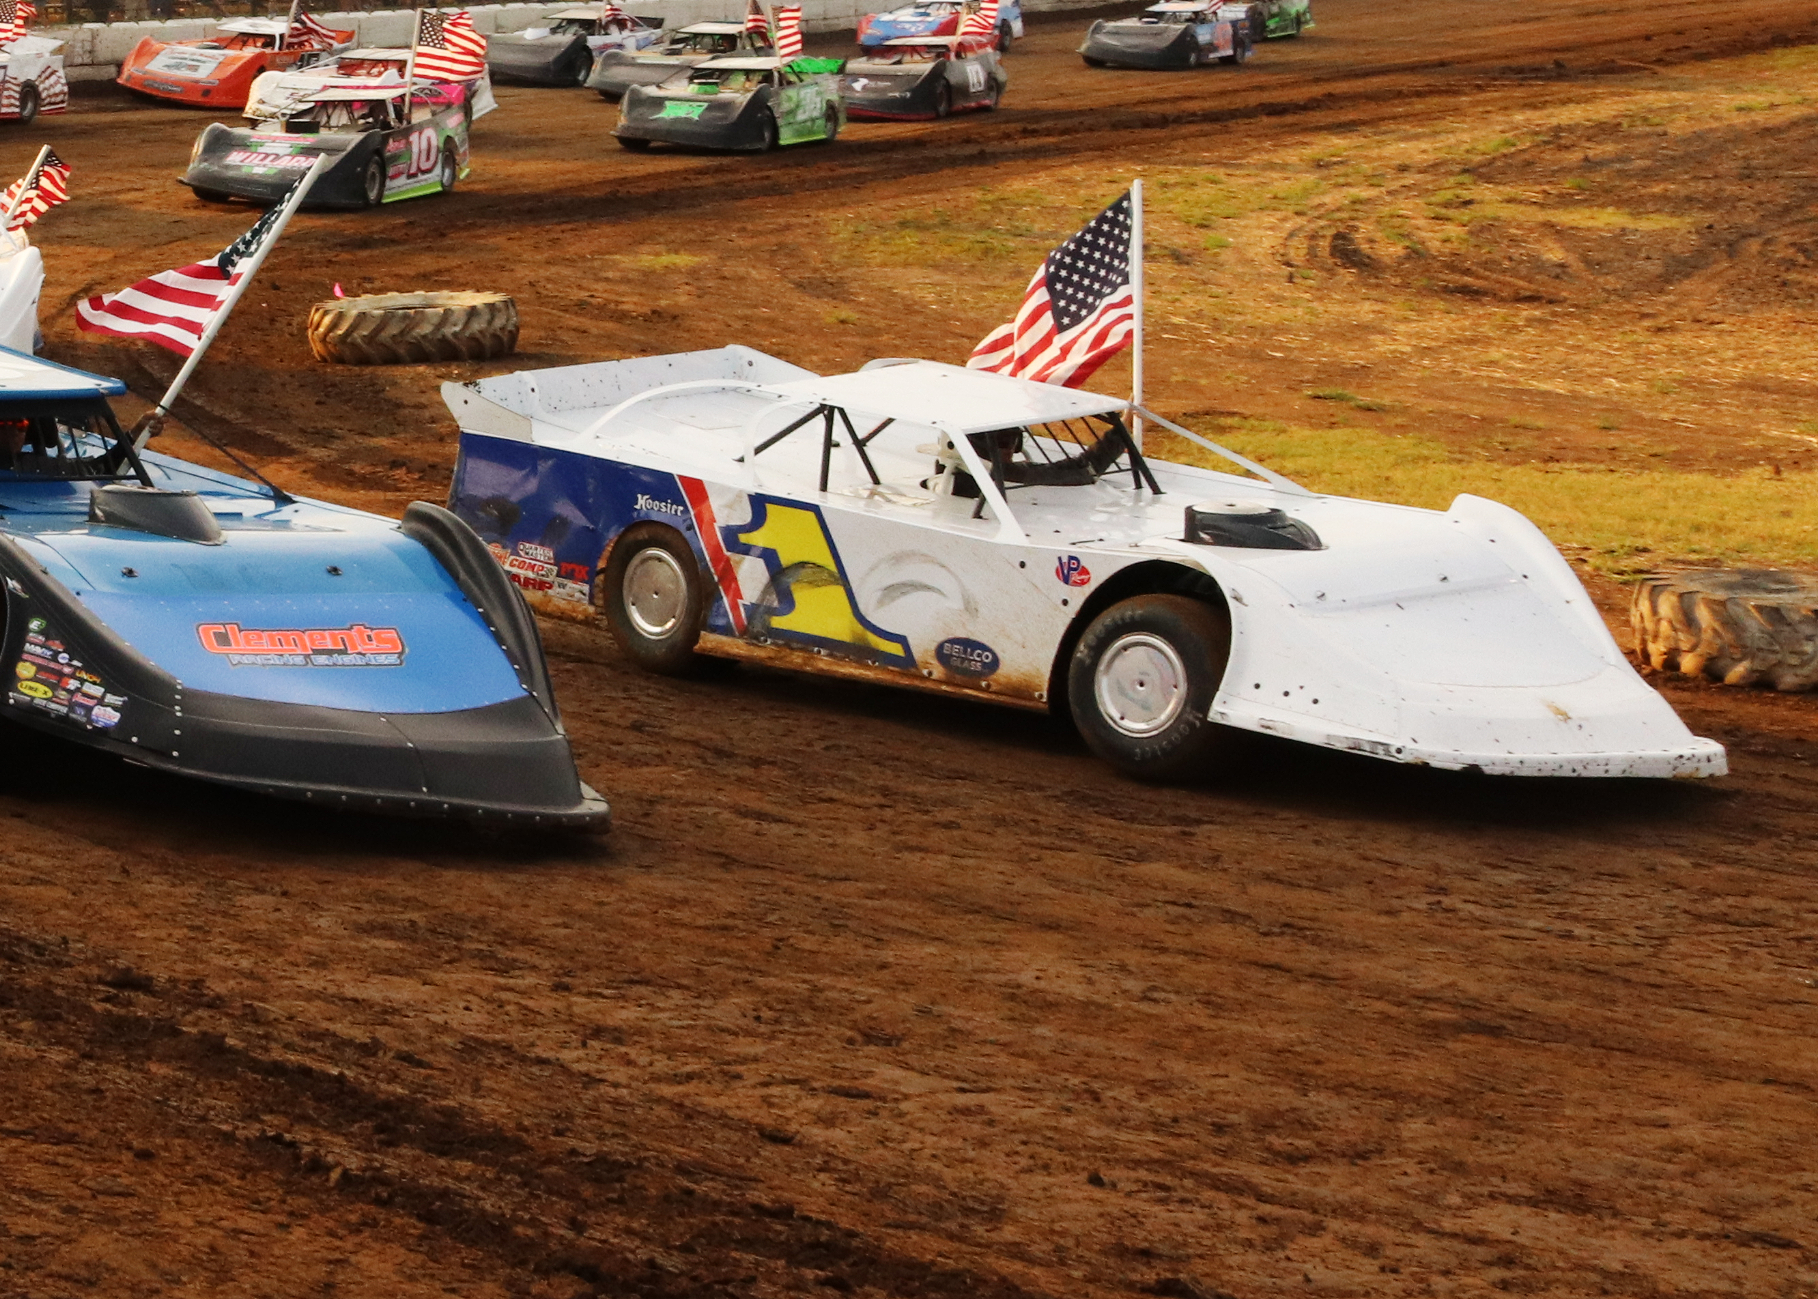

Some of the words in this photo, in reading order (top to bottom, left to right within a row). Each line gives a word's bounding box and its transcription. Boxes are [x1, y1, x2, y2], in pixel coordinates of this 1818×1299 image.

[408, 127, 439, 177] 10
[634, 493, 684, 517] Hoosier
[509, 557, 546, 574] COMP
[1057, 555, 1081, 585] VP
[727, 495, 912, 667] 1
[198, 623, 403, 654] Clements
[312, 653, 401, 666] ENGINES
[943, 643, 993, 663] BELLCO
